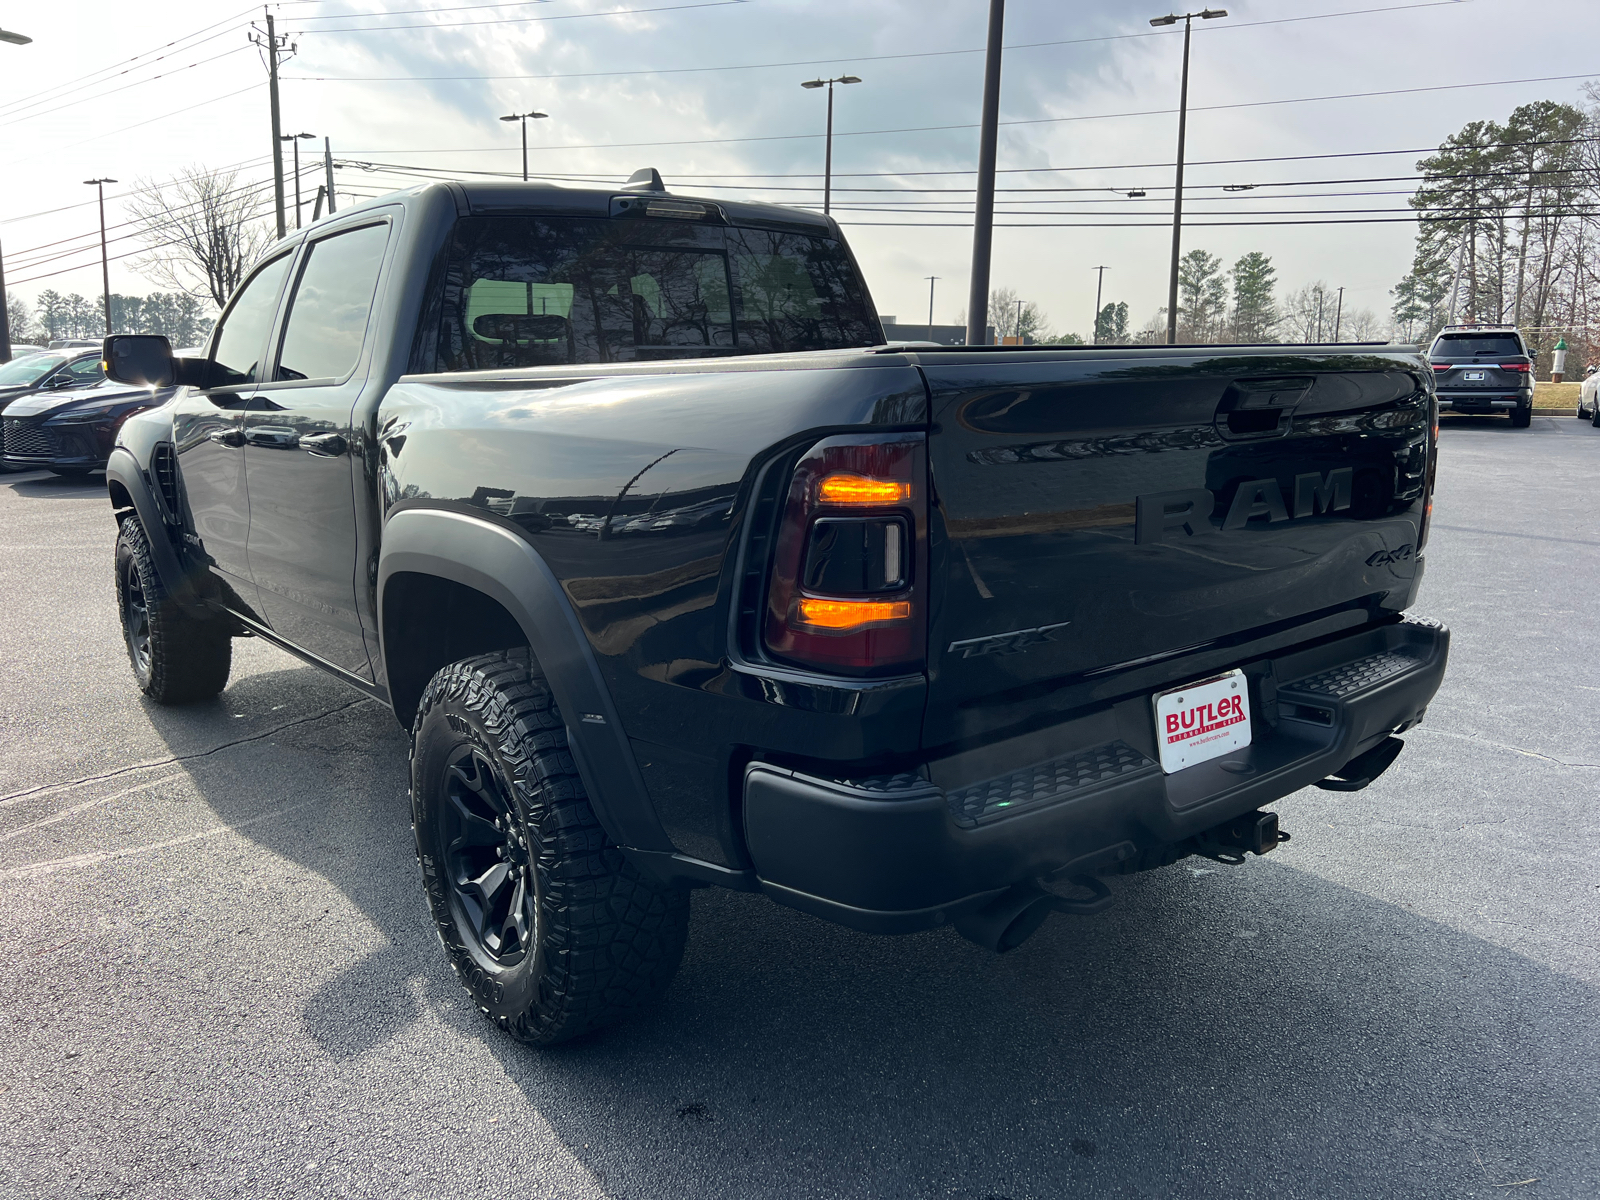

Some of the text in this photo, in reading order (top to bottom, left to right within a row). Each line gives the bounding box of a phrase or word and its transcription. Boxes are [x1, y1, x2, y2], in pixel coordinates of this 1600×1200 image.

[1134, 466, 1353, 545] RAM
[1168, 714, 1245, 743] AUTOMOTIVE GROUP
[1189, 731, 1230, 747] www.butlercars.com
